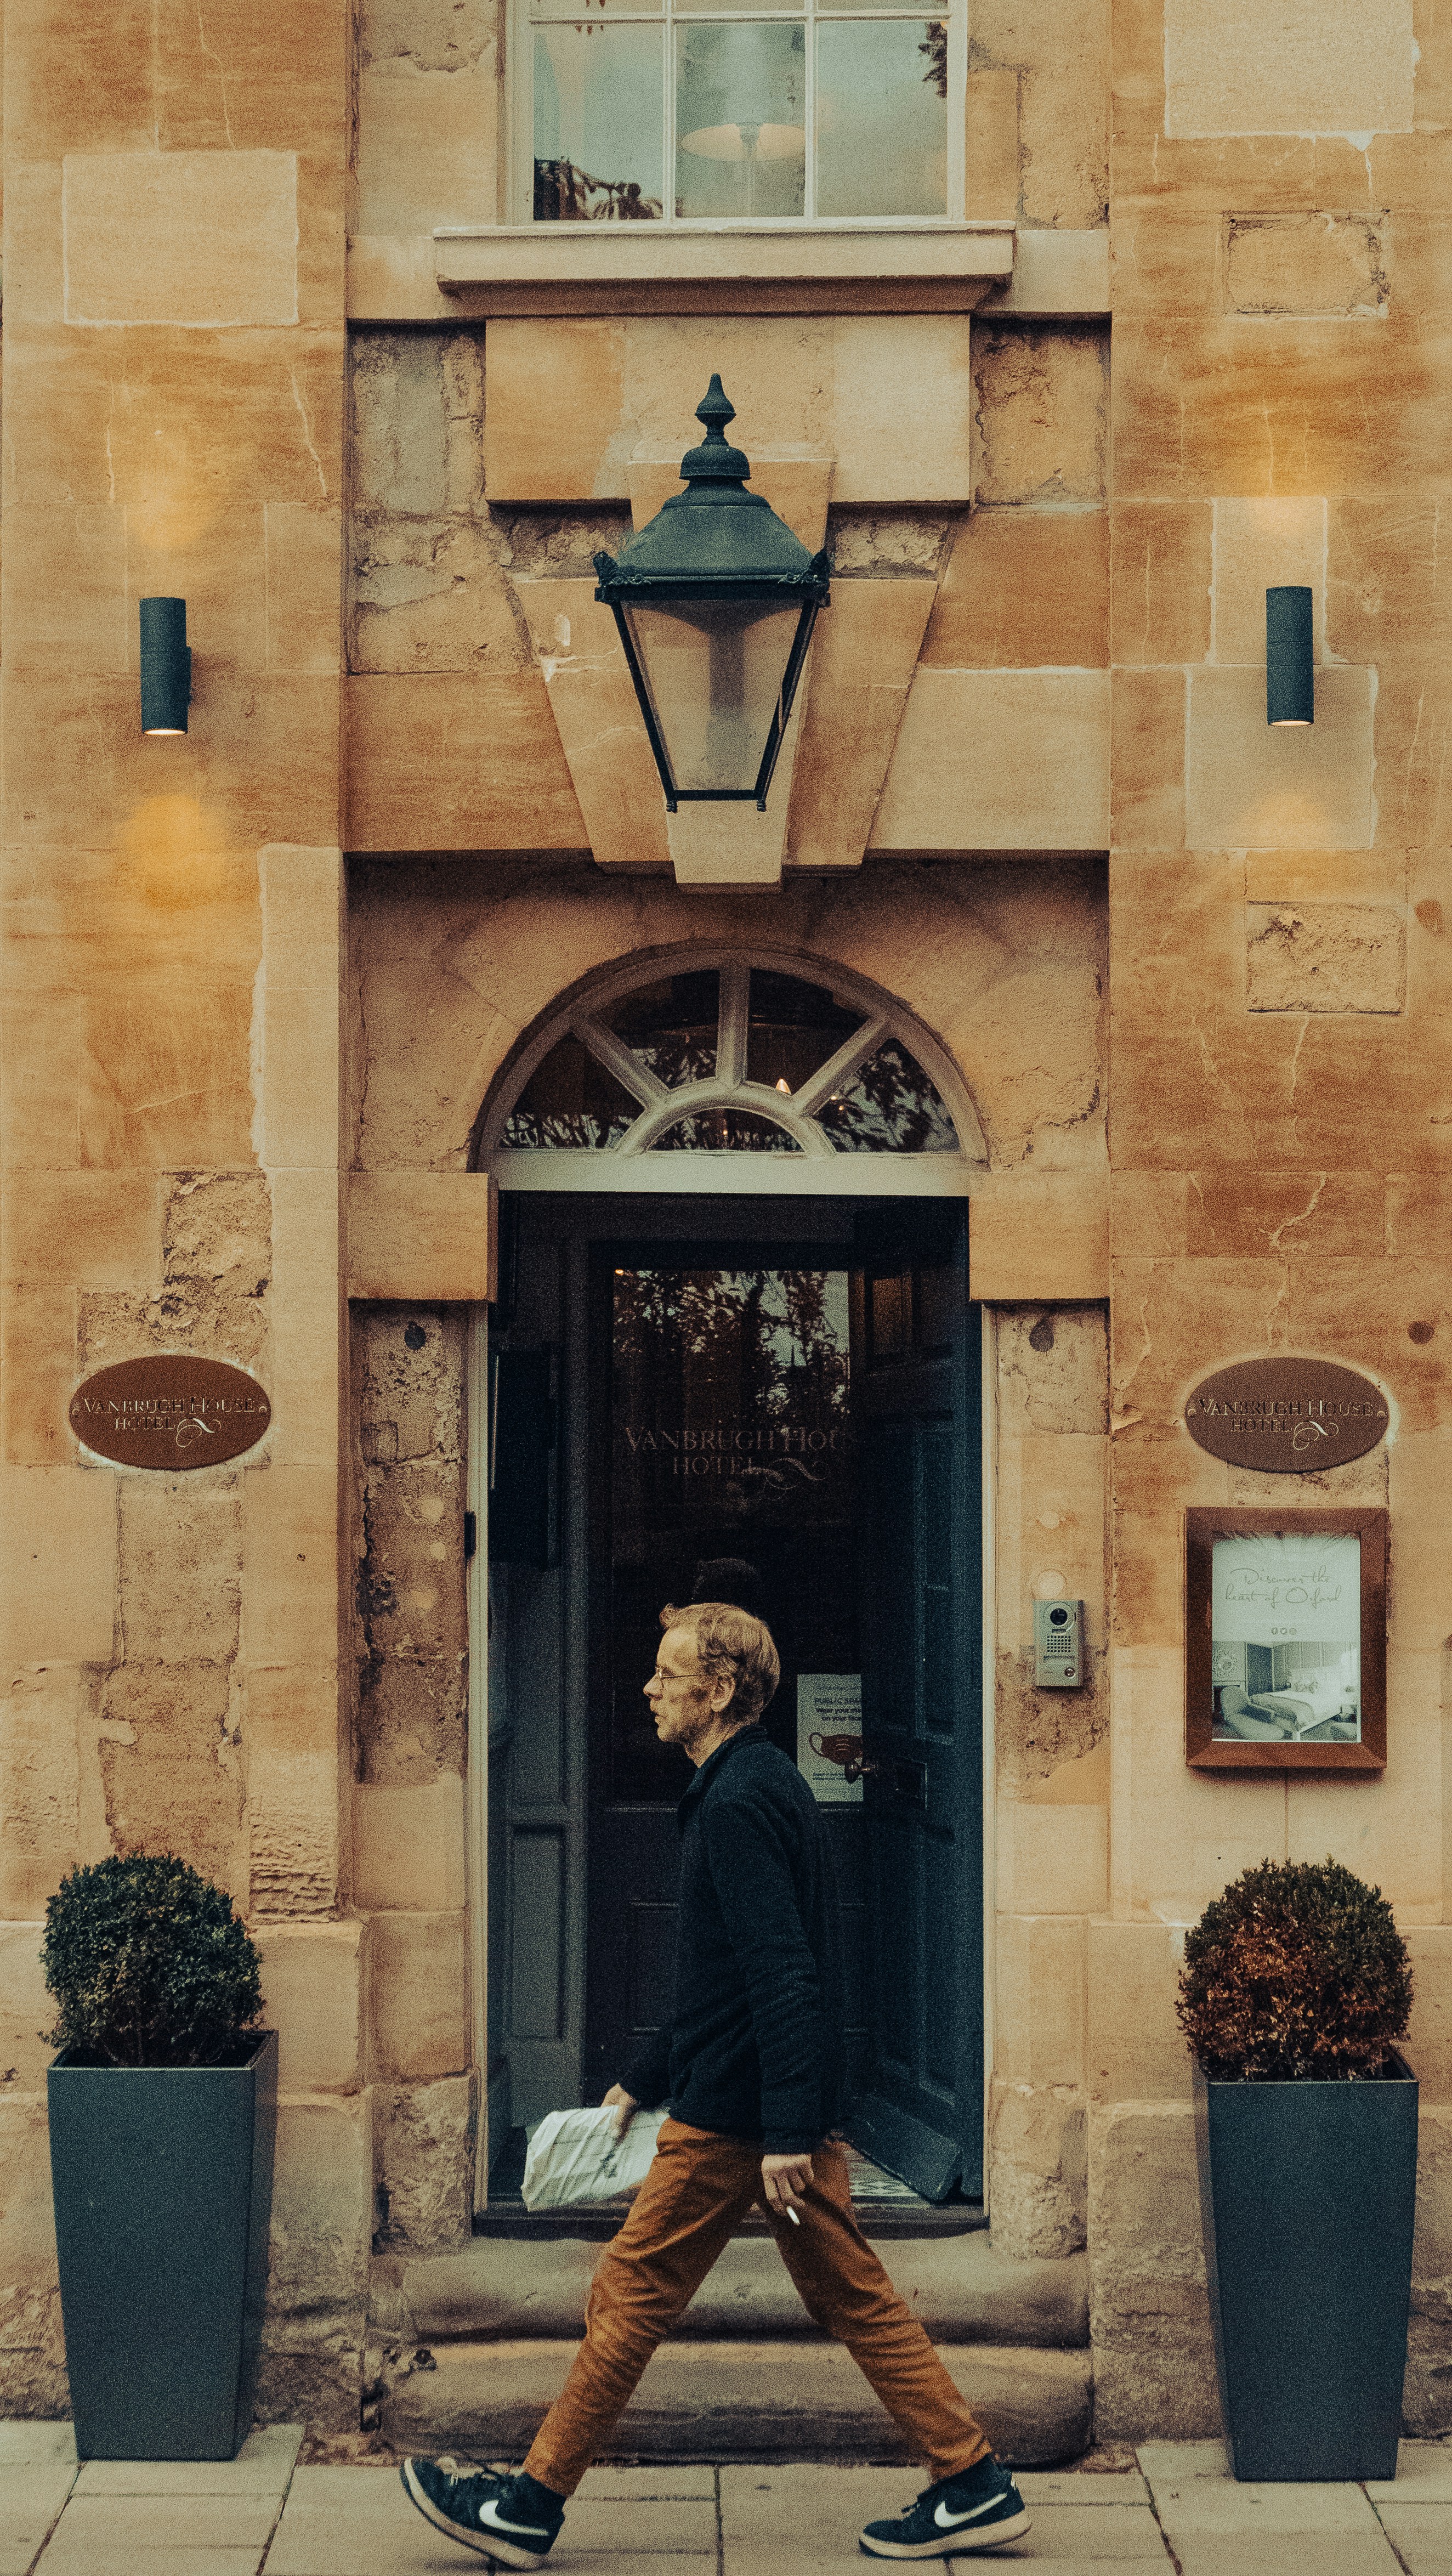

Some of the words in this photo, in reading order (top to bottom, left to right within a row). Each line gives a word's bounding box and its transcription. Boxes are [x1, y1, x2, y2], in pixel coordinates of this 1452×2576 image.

[82, 1397, 185, 1414] VANBRUGH
[189, 1396, 256, 1414] HOUSE
[1199, 1399, 1302, 1417] VANBRUGH
[1306, 1399, 1374, 1417] HOUSE
[114, 1417, 175, 1431] HOTEL
[1230, 1418, 1292, 1433] HOTEL
[625, 1426, 775, 1452] VANBRUGH
[672, 1456, 753, 1475] HOTEL
[1229, 1567, 1304, 1586] Discover
[1307, 1565, 1332, 1584] the
[1224, 1583, 1263, 1603] heart
[1264, 1587, 1280, 1609] of
[1285, 1586, 1343, 1609] Oxford
